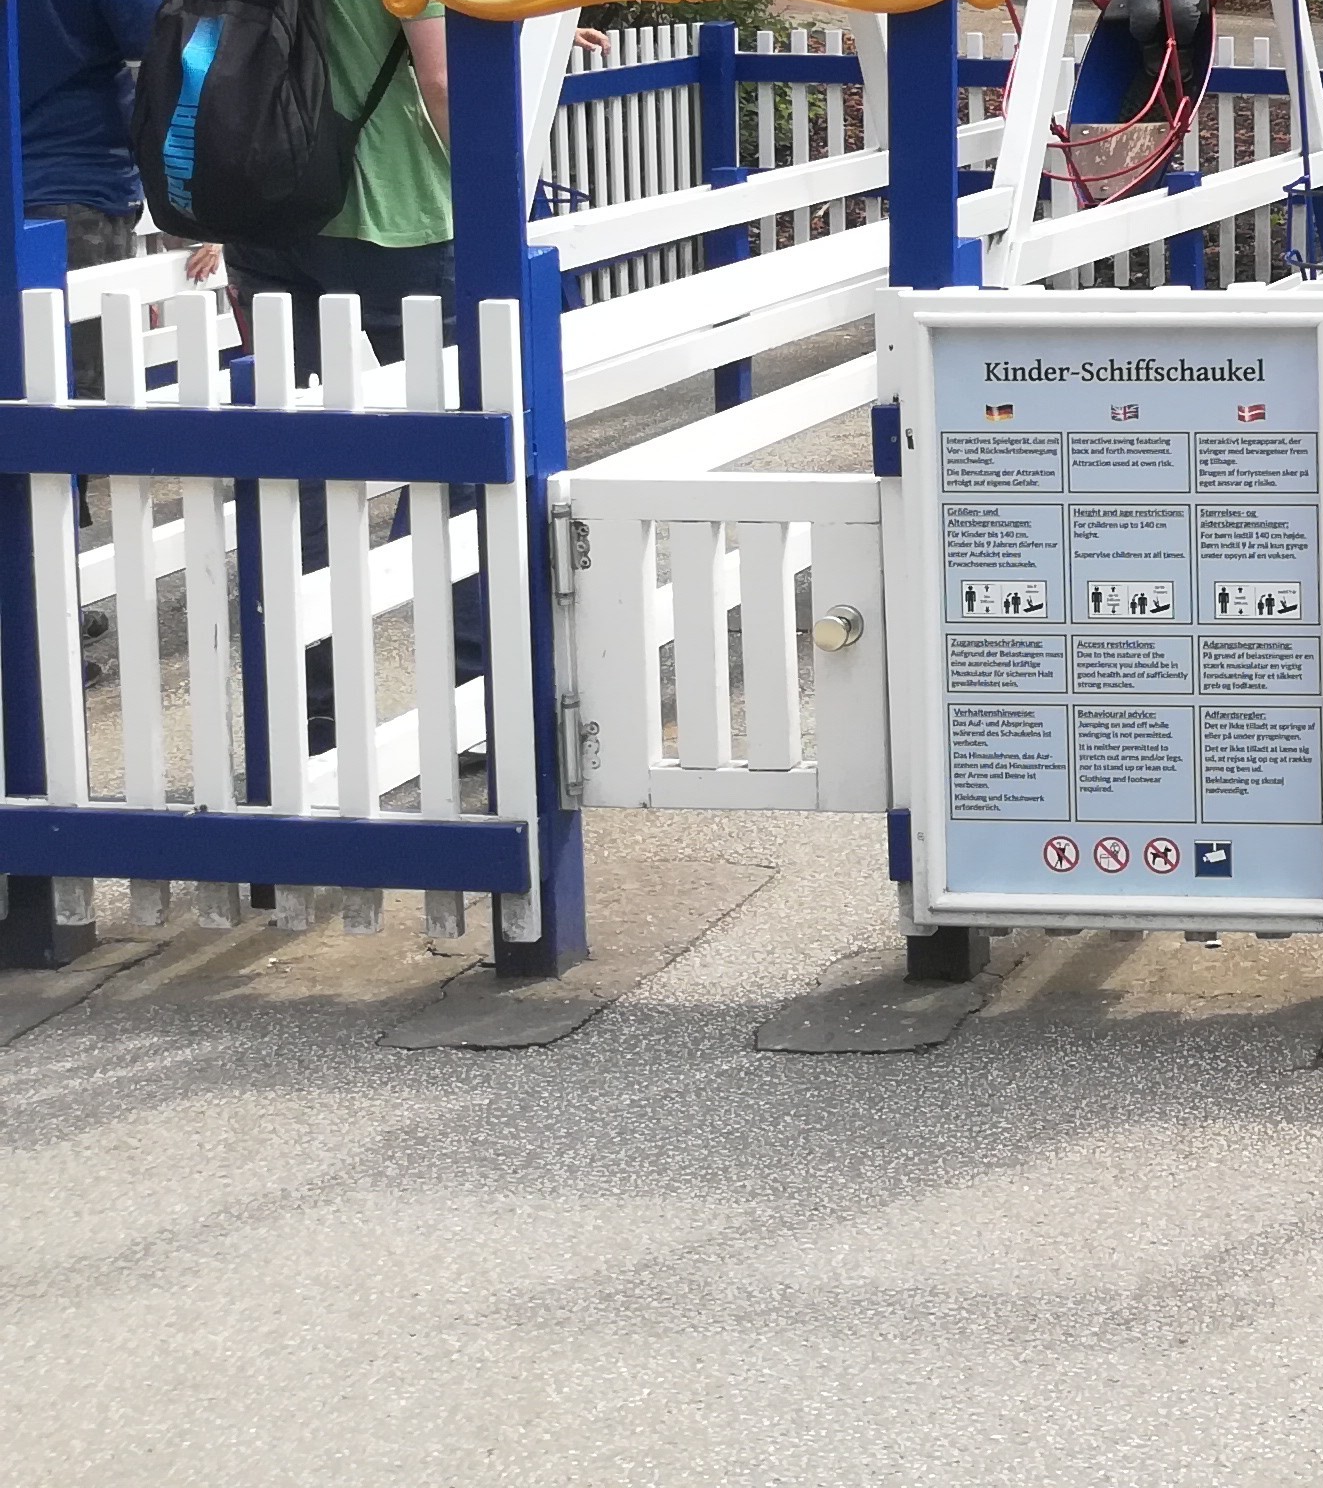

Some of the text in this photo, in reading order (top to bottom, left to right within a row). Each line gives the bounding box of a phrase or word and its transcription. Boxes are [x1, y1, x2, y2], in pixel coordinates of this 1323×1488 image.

[164, 105, 198, 200] PUMA
[985, 360, 1266, 383] Kinder-Schiffschaukel
[1077, 641, 1104, 649] Access
